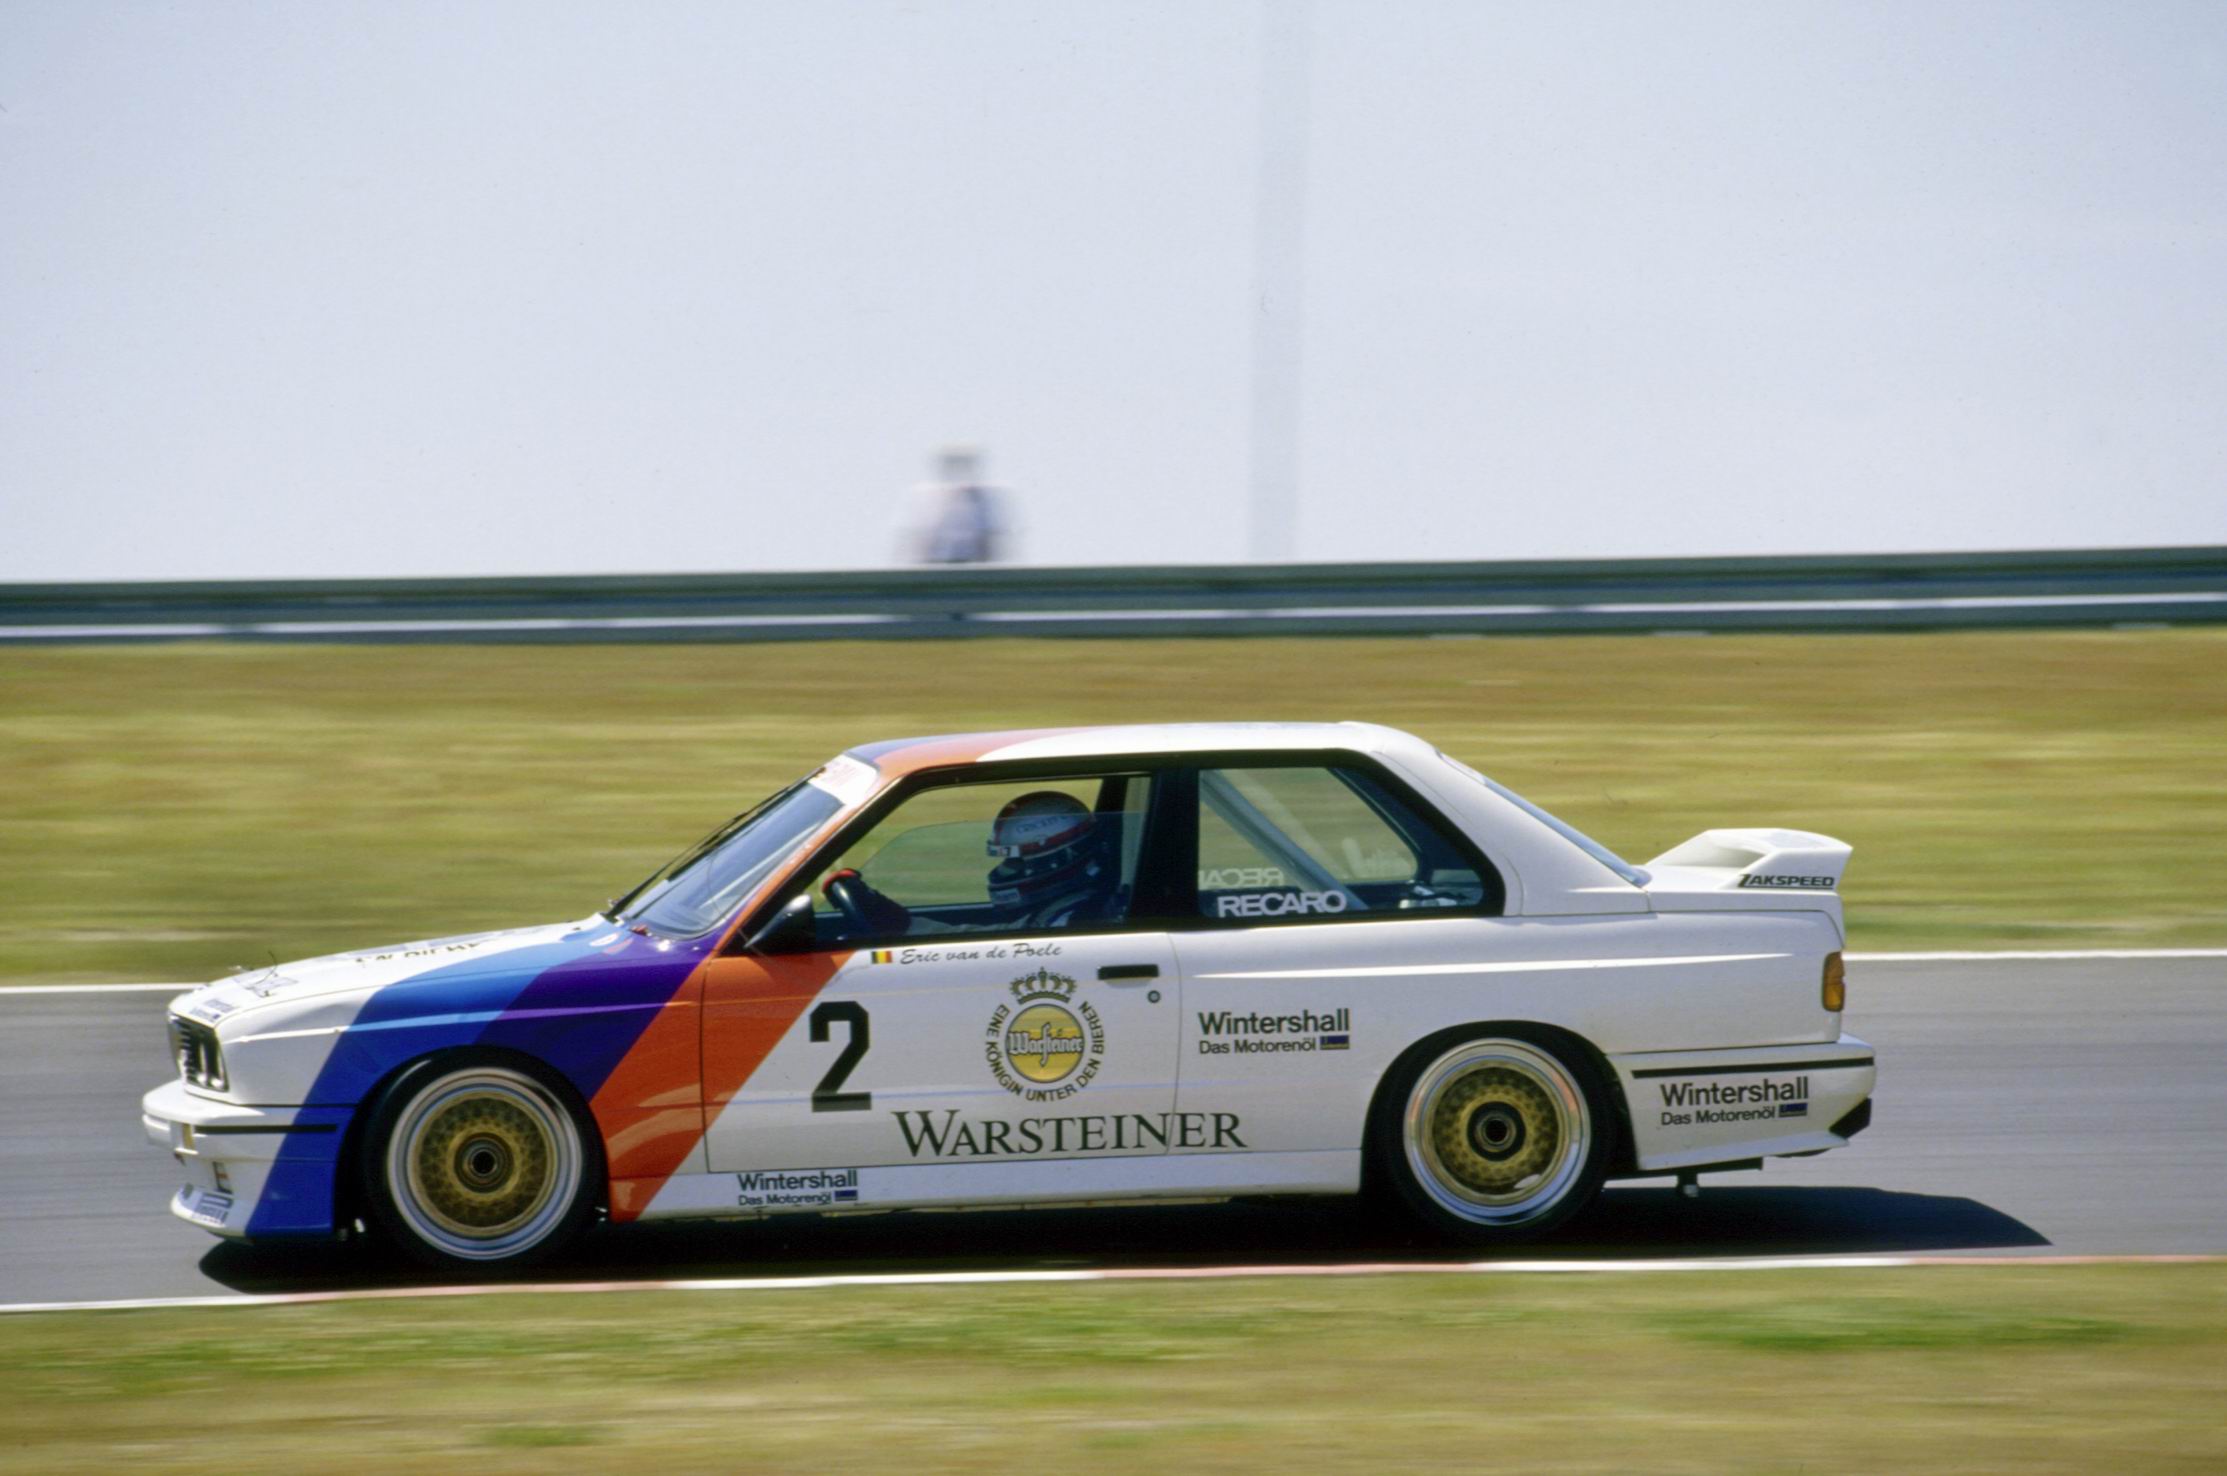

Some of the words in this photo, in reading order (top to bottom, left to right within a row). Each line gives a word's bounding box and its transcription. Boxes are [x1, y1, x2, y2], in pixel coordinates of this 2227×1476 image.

[1737, 873, 1836, 889] ZAKSPEED
[1217, 889, 1347, 919] RECARO
[900, 948, 942, 965] Eric
[946, 951, 980, 961] van
[985, 945, 1007, 959] de
[1012, 942, 1063, 959] Poele
[986, 1003, 1011, 1039] EINE
[1078, 1000, 1105, 1055] BIEREN
[1197, 1007, 1350, 1035] Wintershall
[809, 1001, 872, 1113] 2
[1199, 1040, 1231, 1055] Das
[1234, 1037, 1316, 1054] Motorenöl
[985, 1041, 1024, 1096] KÖNIGIN
[1075, 1058, 1102, 1088] DEN
[1025, 1083, 1078, 1102] UNTER
[1660, 1075, 1809, 1107] Wintershall
[1661, 1112, 1692, 1126] Das
[1696, 1106, 1775, 1124] Motorenöl
[890, 1108, 1249, 1158] WARSTEINER
[737, 1169, 858, 1191] Wintershall
[738, 1195, 763, 1206] Das
[766, 1192, 832, 1205] Motorenöl
